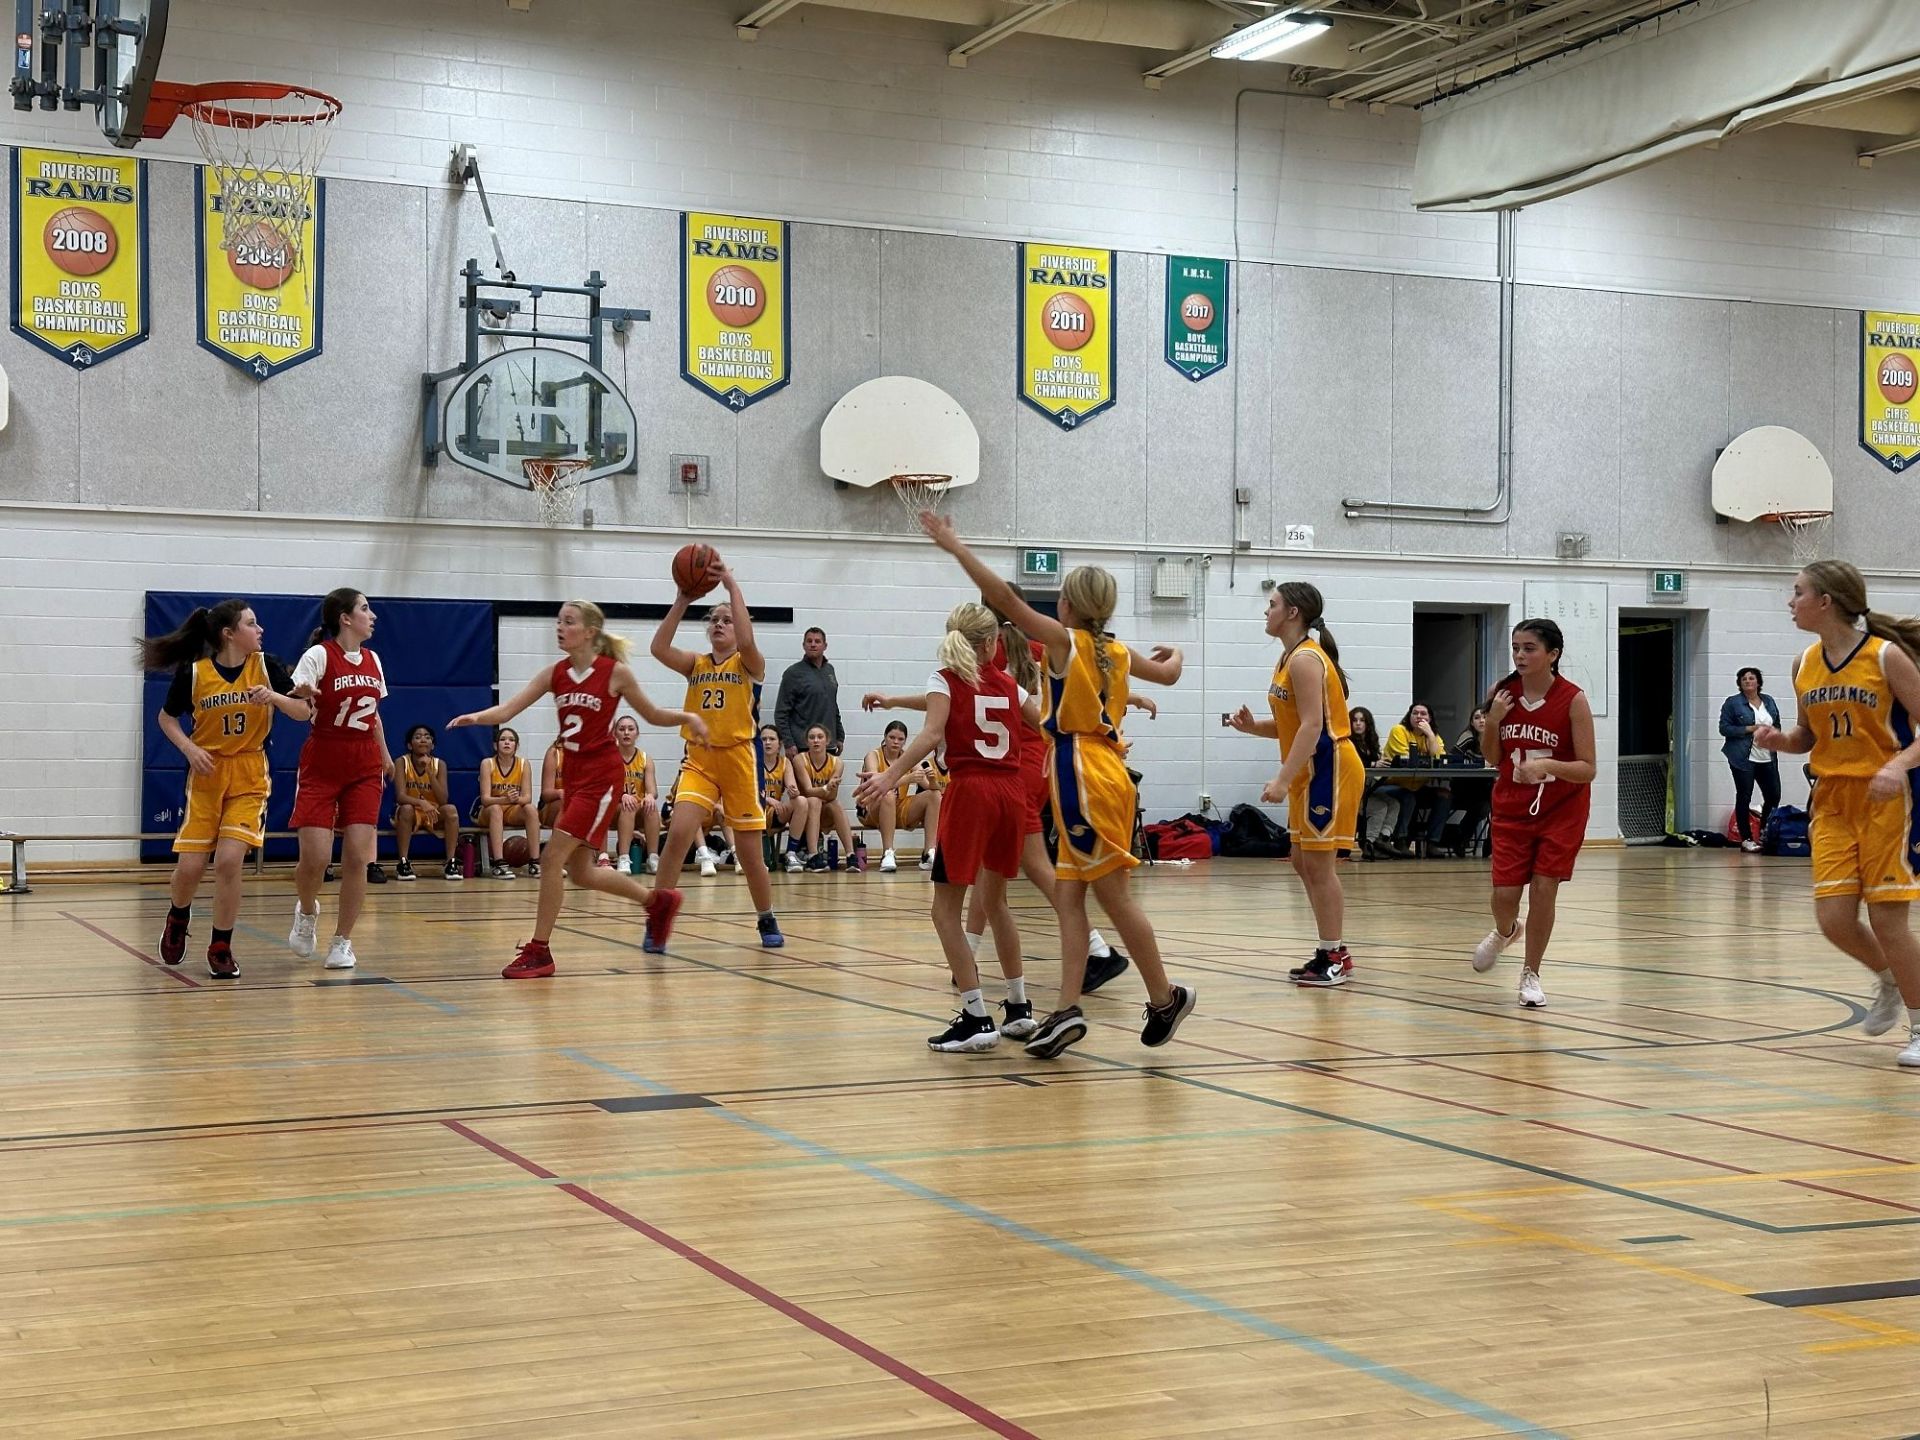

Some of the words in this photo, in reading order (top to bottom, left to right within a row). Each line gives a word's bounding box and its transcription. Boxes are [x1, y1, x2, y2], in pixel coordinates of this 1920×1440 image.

[40, 162, 120, 184] RIVERSIDE
[26, 178, 134, 203] RAMS
[52, 229, 108, 253] 2008
[704, 225, 769, 244] RIVERSIDE
[692, 239, 779, 262] RAMS
[1040, 254, 1097, 271] RIVERSIDE
[1029, 268, 1107, 289] RAMS
[60, 281, 101, 298] BOYS
[715, 284, 757, 307] 2010
[33, 297, 128, 318] BASKETBALL
[243, 293, 278, 312] BOYS
[1185, 304, 1209, 318] 2017
[35, 316, 127, 335] CHAMPIONS
[218, 310, 303, 332] BASKETBALL
[1050, 311, 1086, 331] 2011
[1876, 321, 1920, 335] RIVERSIDE
[219, 328, 302, 349] CHAMPIONS
[719, 331, 752, 347] BOYS
[1187, 333, 1206, 343] BOYS
[698, 346, 774, 364] BASKETBALL
[1174, 342, 1218, 354] BASKETBALL
[1053, 355, 1082, 369] BOYS
[1175, 352, 1217, 364] CHAMPIONS
[699, 362, 773, 380] CHAMPIONS
[1033, 370, 1101, 386] BASKETBALL
[1882, 369, 1913, 387] 2009
[1034, 384, 1100, 400] CHAMPIONS
[1885, 407, 1909, 420] GIRLS
[1871, 419, 1920, 434] BASKETBAL
[1872, 432, 1920, 446] CHAMPIONS
[1288, 531, 1305, 541] 236
[200, 691, 253, 711] HURRICA
[701, 688, 726, 711] 23
[333, 696, 376, 731] 12
[222, 711, 247, 736] 13
[561, 714, 583, 752] 2
[973, 694, 1010, 760] 5
[1829, 711, 1853, 739] 11
[1500, 723, 1559, 748] BREAKERS
